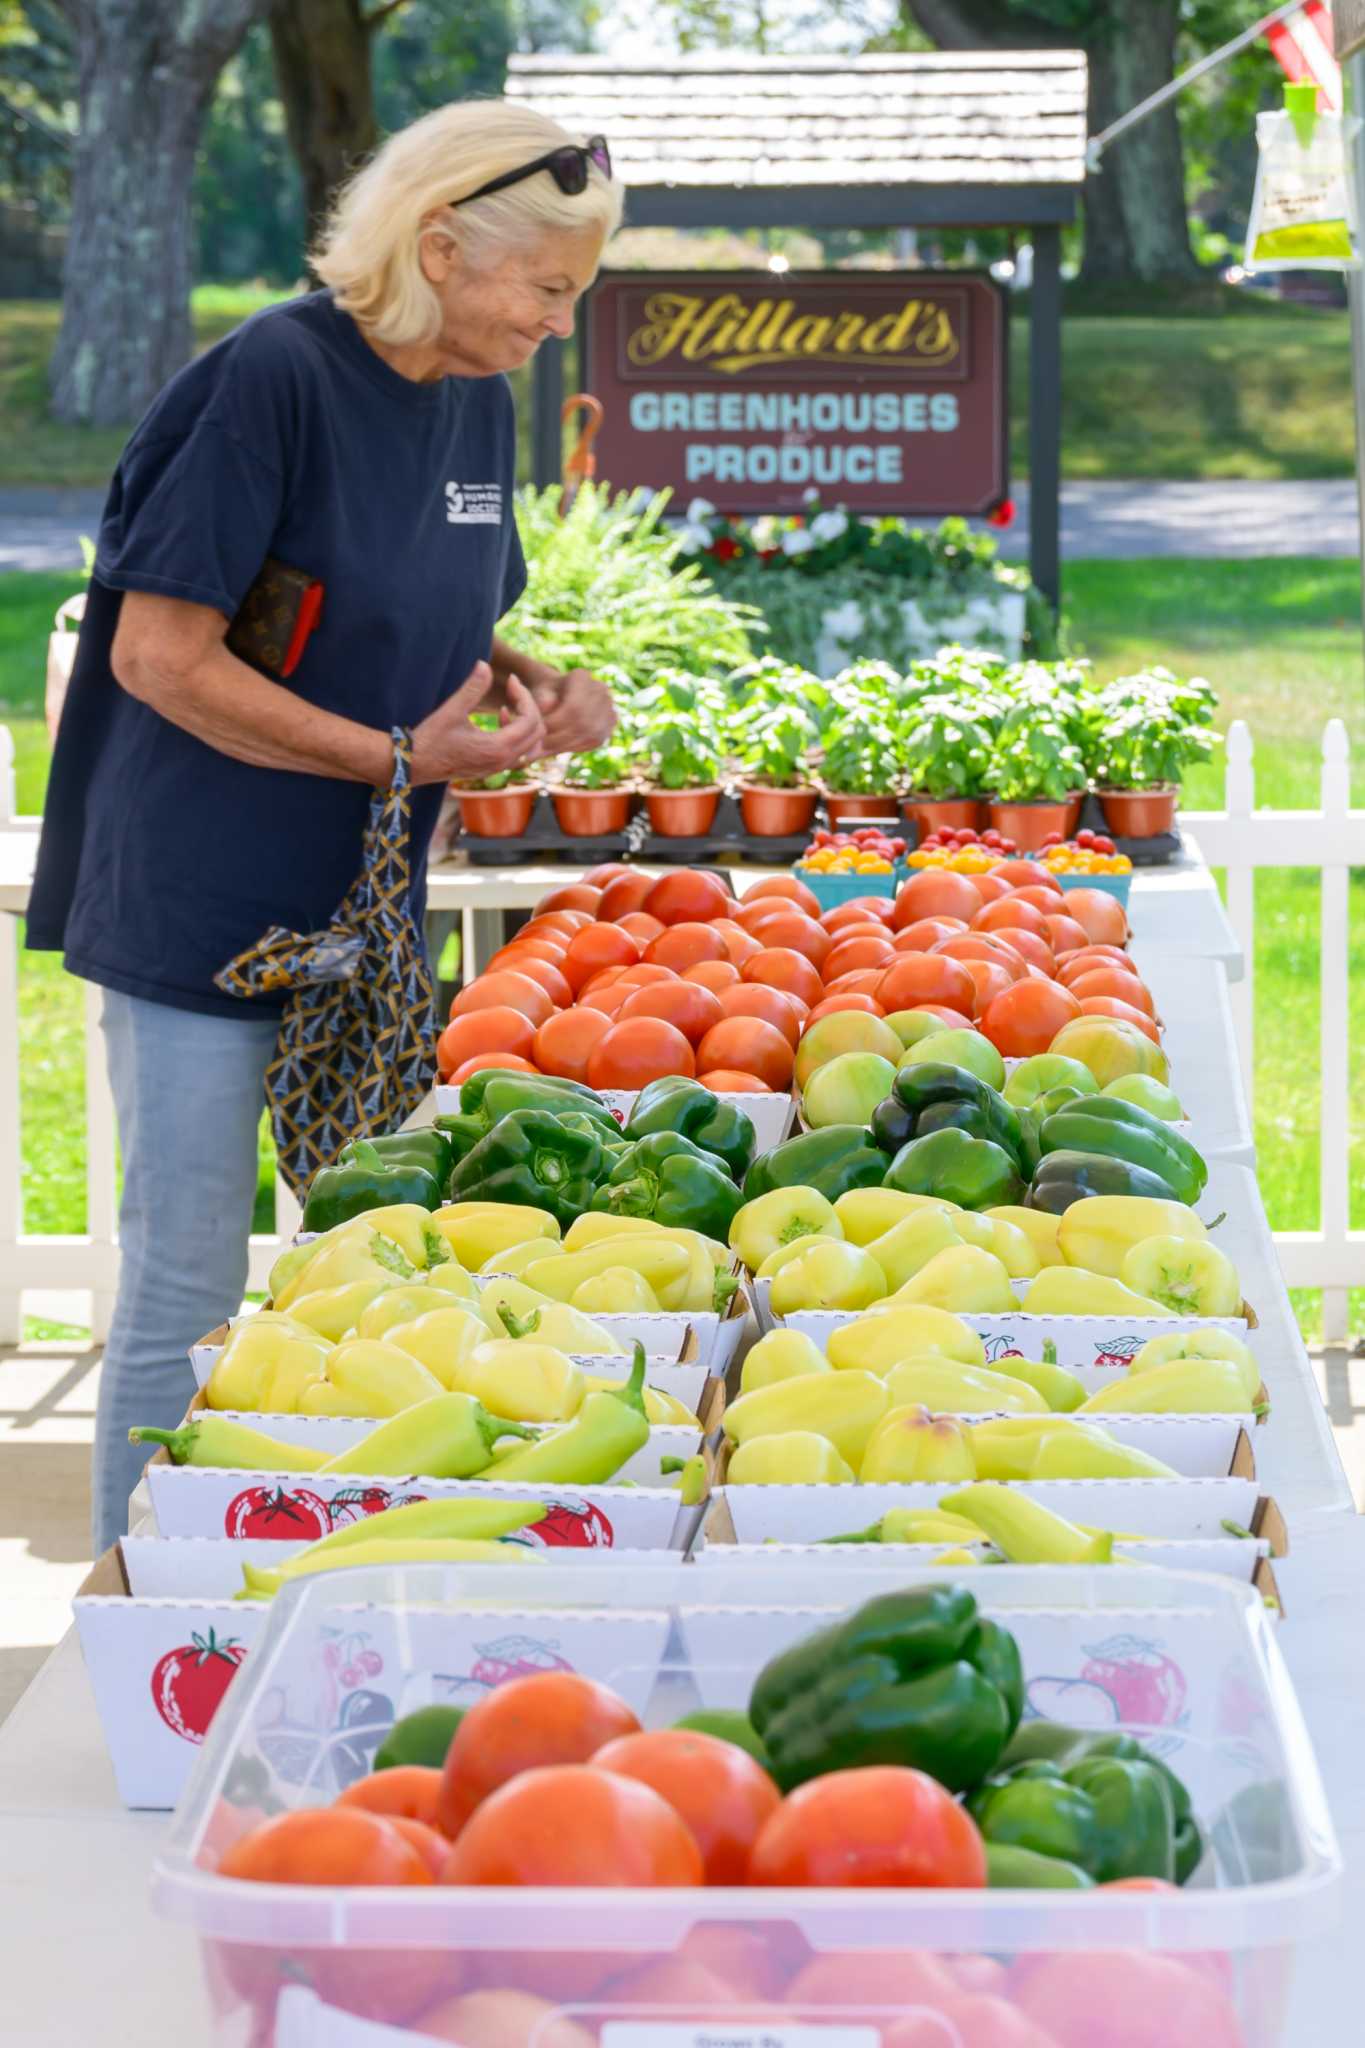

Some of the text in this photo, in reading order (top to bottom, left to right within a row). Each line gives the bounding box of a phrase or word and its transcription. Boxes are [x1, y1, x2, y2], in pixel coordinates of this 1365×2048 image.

[626, 292, 959, 373] Hillard's
[630, 393, 959, 432] GREENHOUSES
[686, 445, 903, 483] PRODUCE
